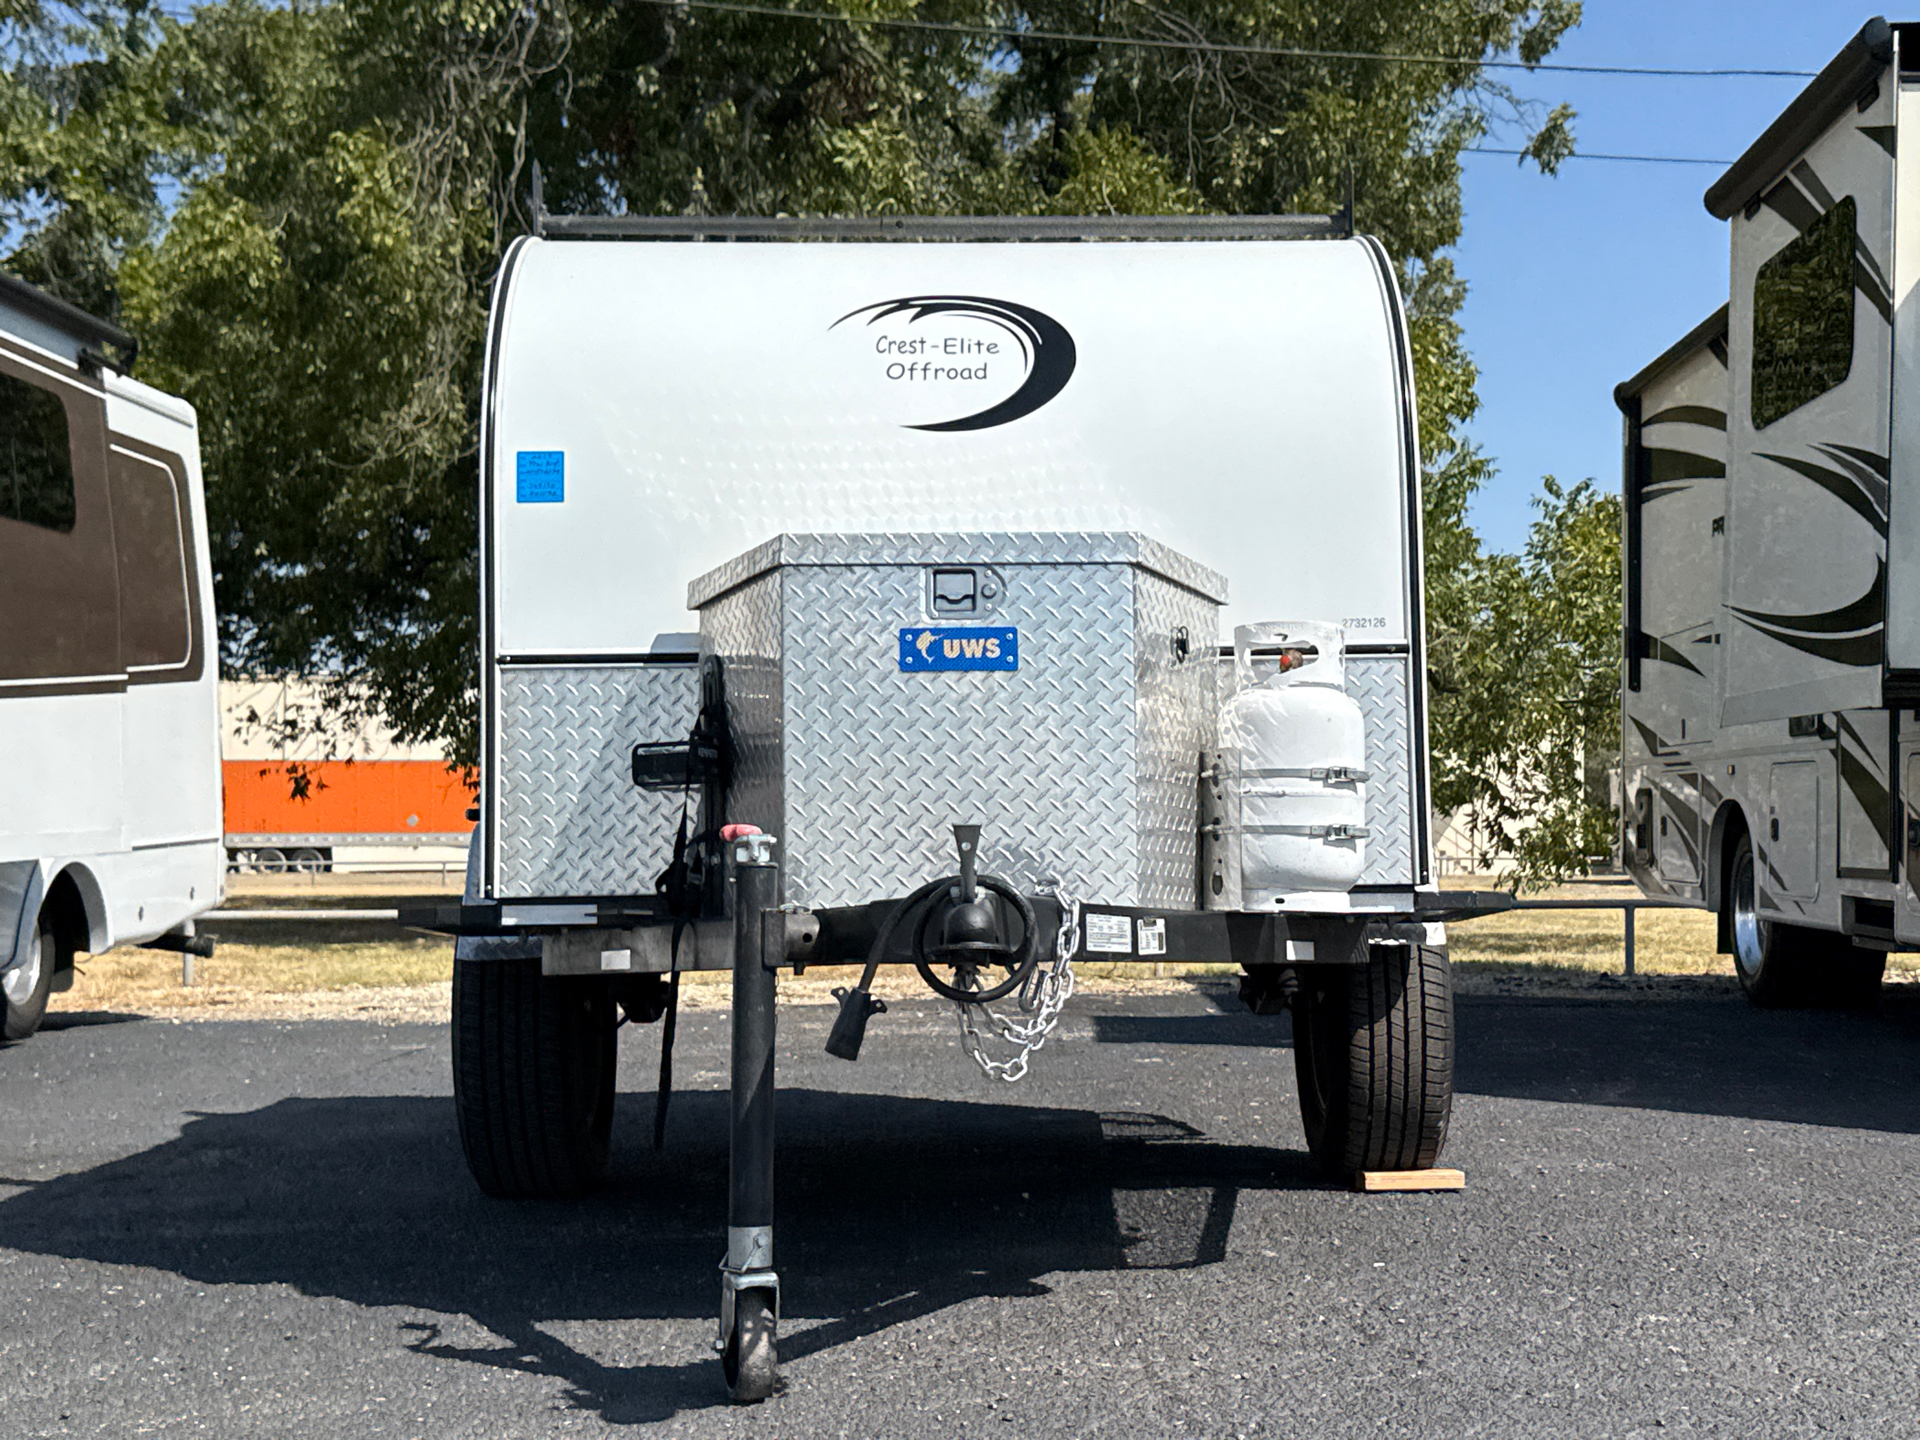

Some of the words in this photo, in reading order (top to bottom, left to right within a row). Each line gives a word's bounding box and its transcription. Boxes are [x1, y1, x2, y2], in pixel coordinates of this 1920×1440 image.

[876, 335, 1000, 355] Crest-Elite
[886, 362, 988, 381] Offroad
[1341, 617, 1386, 629] 2732126
[943, 637, 1001, 659] UWS
